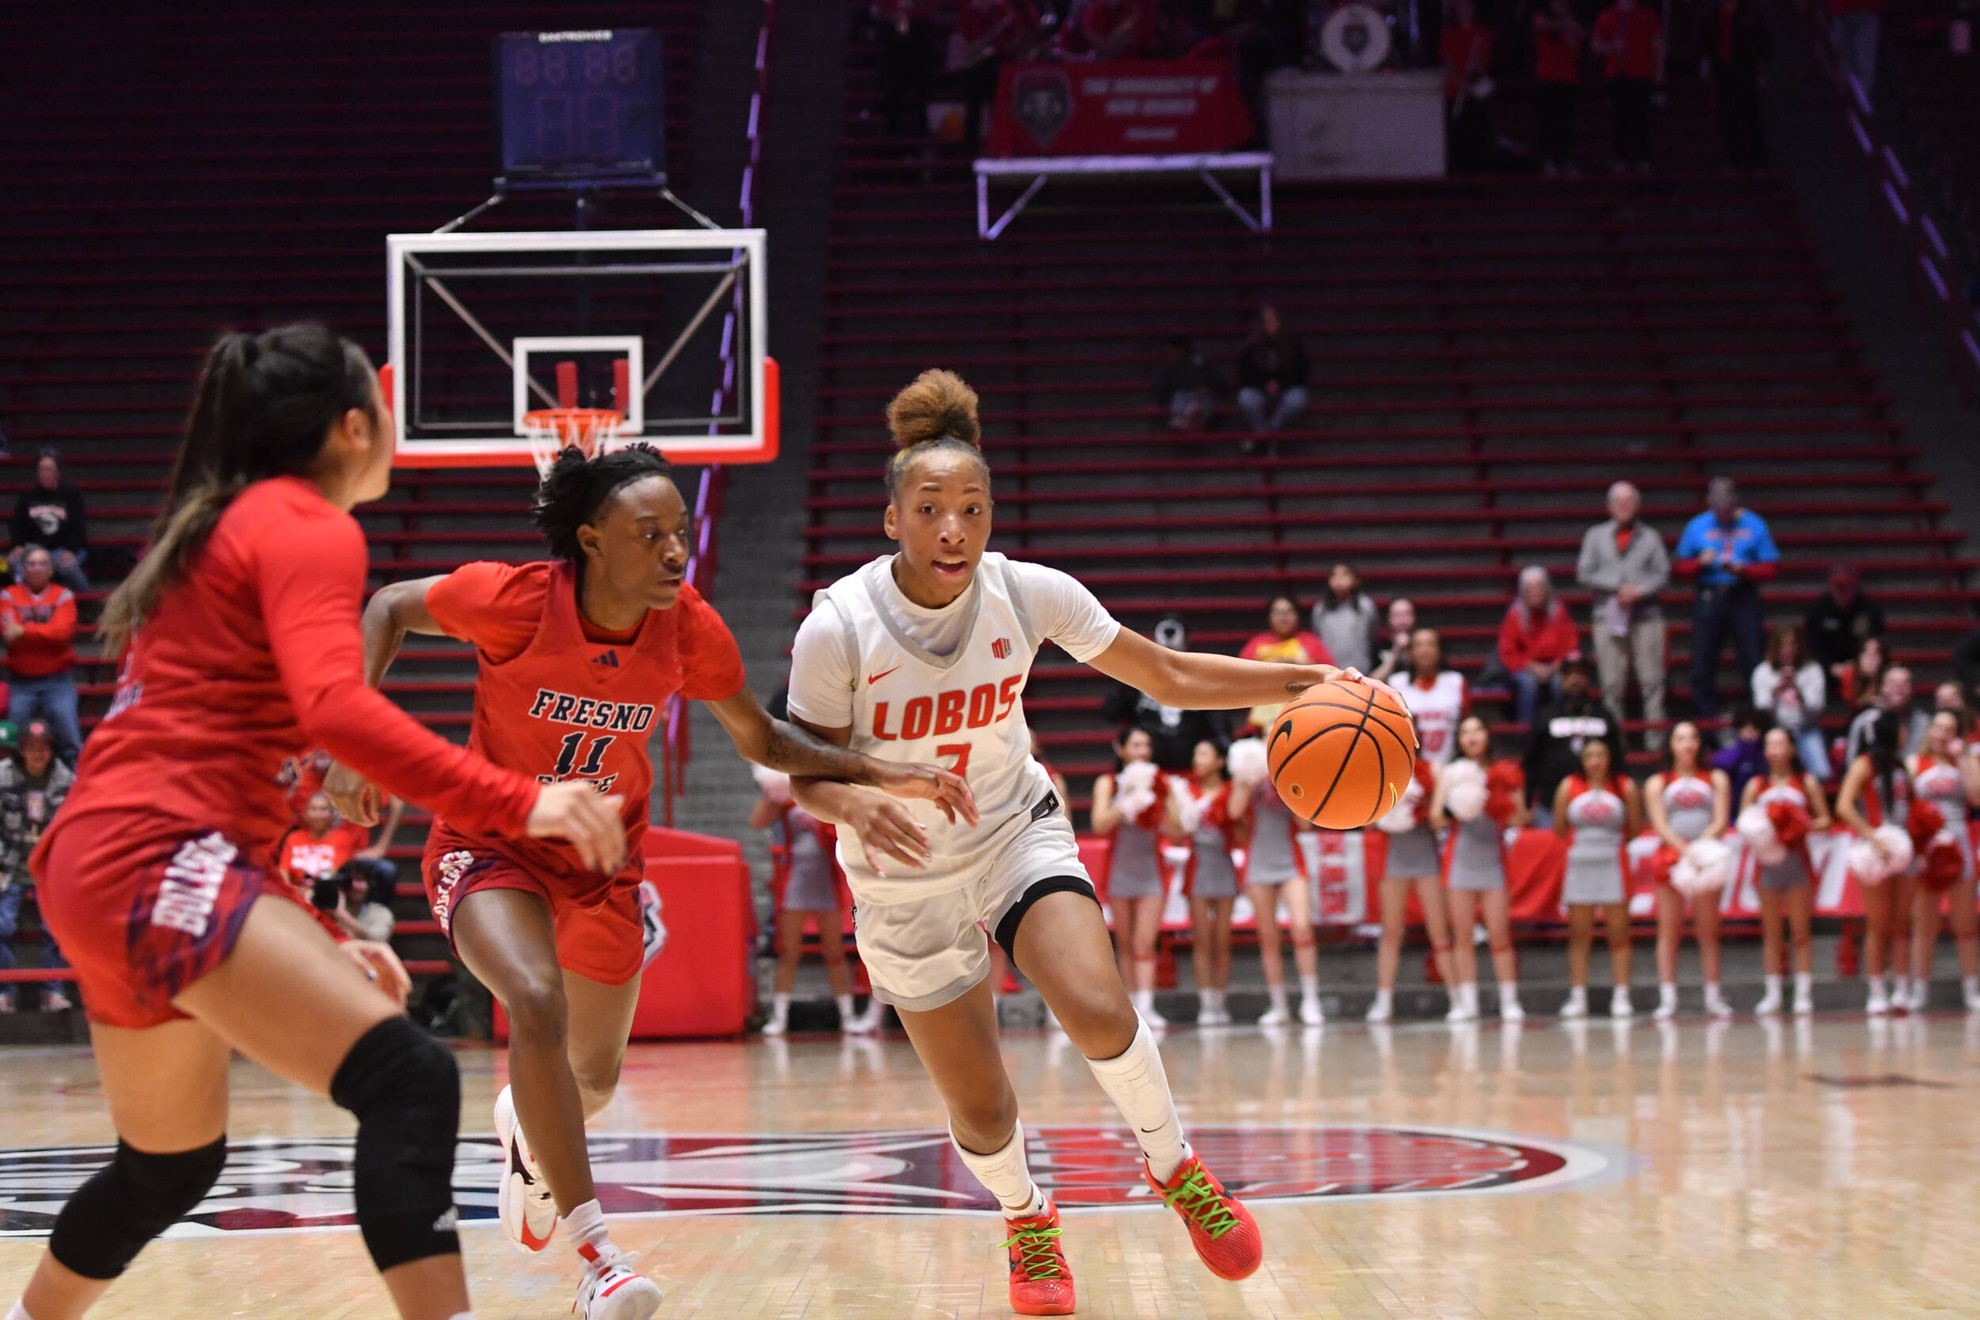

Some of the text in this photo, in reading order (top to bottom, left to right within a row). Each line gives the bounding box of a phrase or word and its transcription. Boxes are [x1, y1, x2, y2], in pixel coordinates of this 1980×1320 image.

[528, 687, 655, 732] FRESNO
[872, 673, 1023, 741] LOBOS
[554, 731, 617, 776] 11
